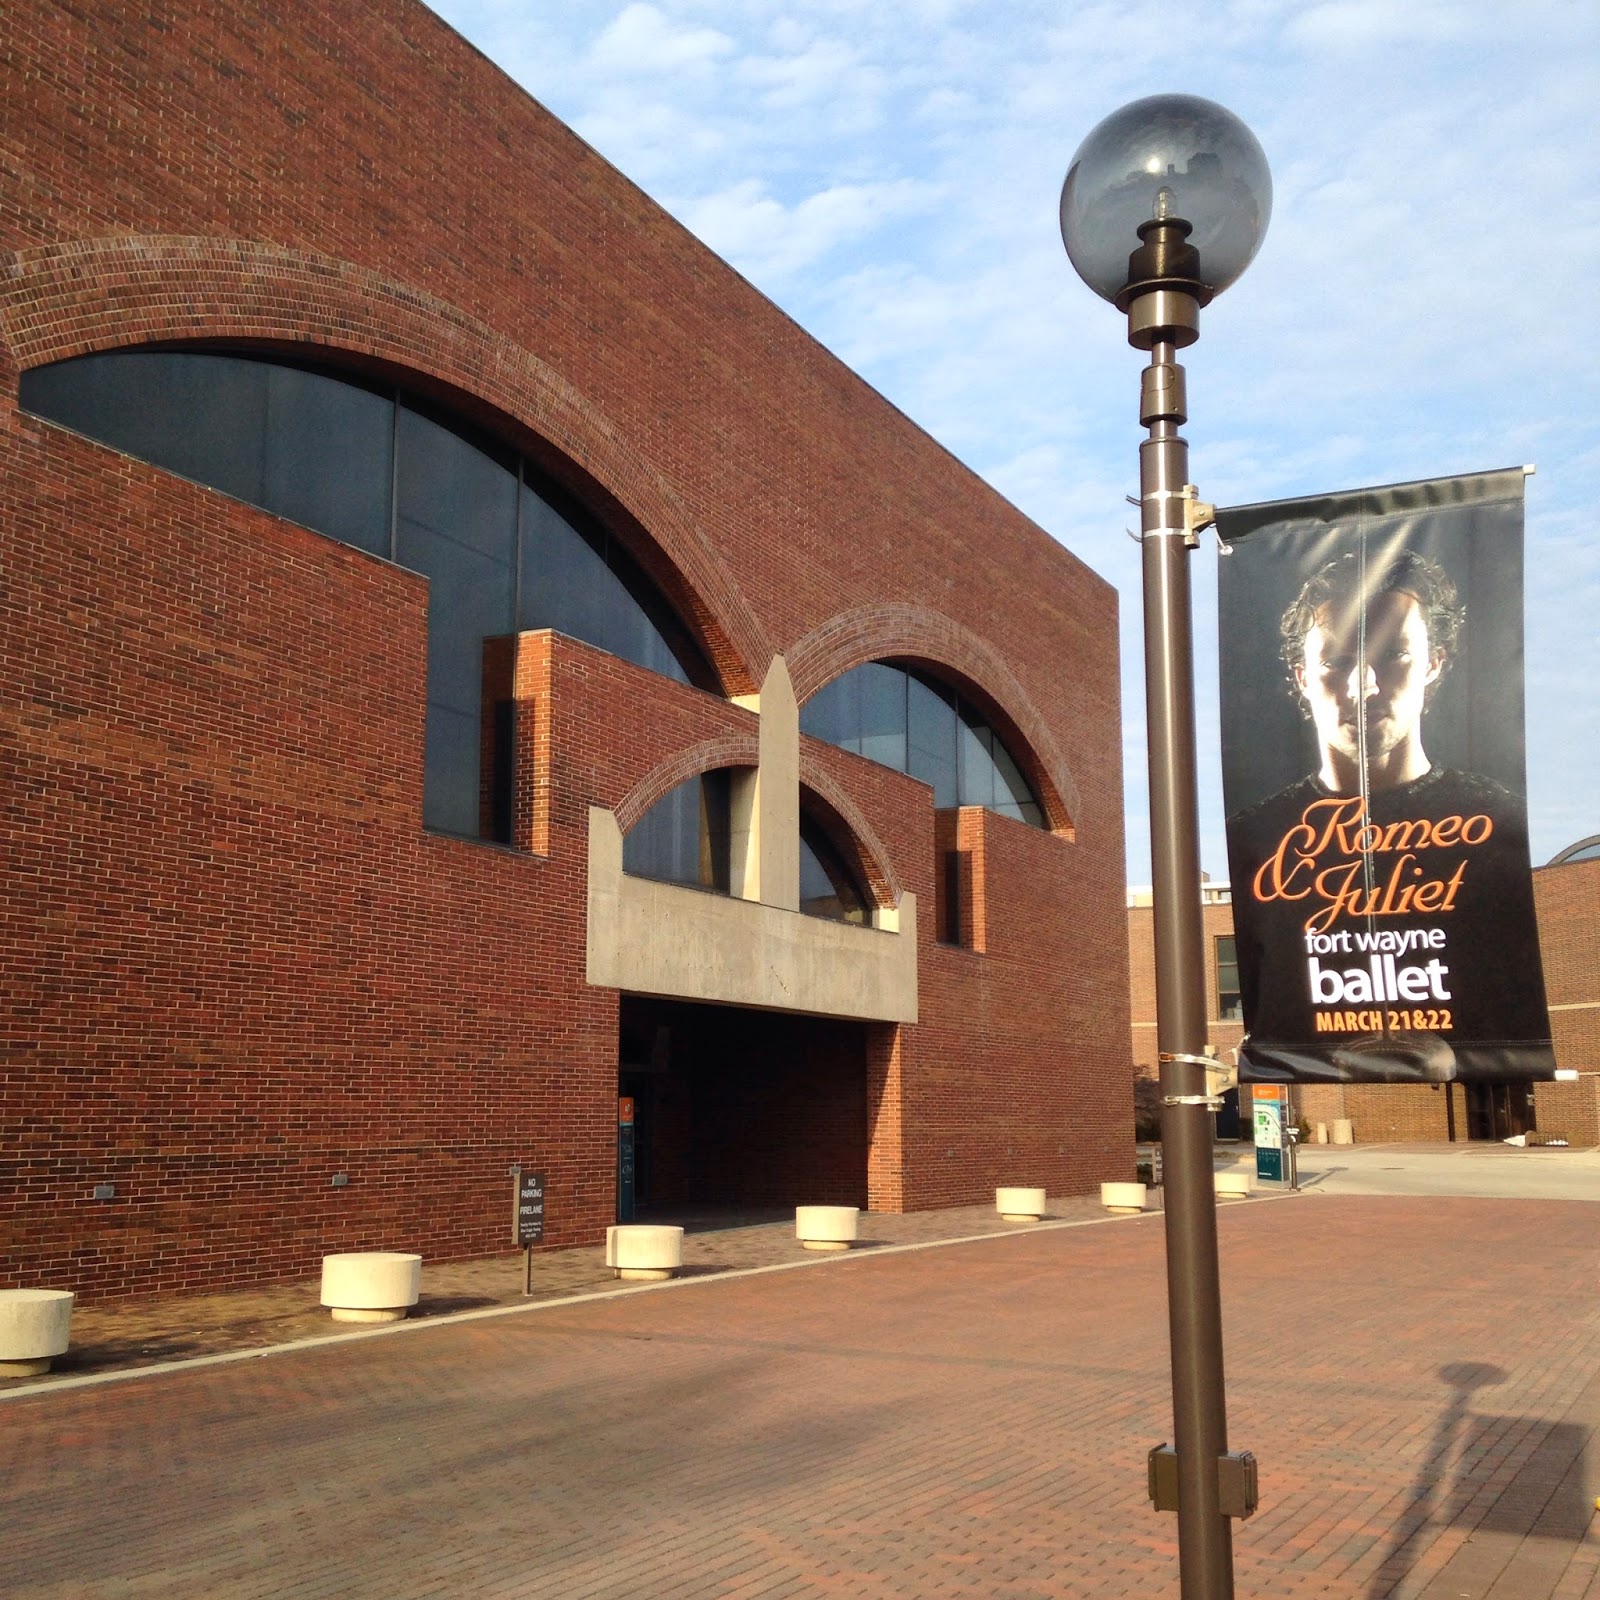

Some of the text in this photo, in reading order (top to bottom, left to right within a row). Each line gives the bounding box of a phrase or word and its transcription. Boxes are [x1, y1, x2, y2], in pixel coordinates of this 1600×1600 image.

[1294, 796, 1494, 857] Romeo
[1304, 854, 1468, 934] Juliet
[1304, 927, 1446, 957] fort wayne
[1307, 953, 1451, 1004] ballet
[1315, 1009, 1453, 1032] MARCH 21&22
[521, 1188, 542, 1198] PARKING
[528, 1178, 536, 1187] NO
